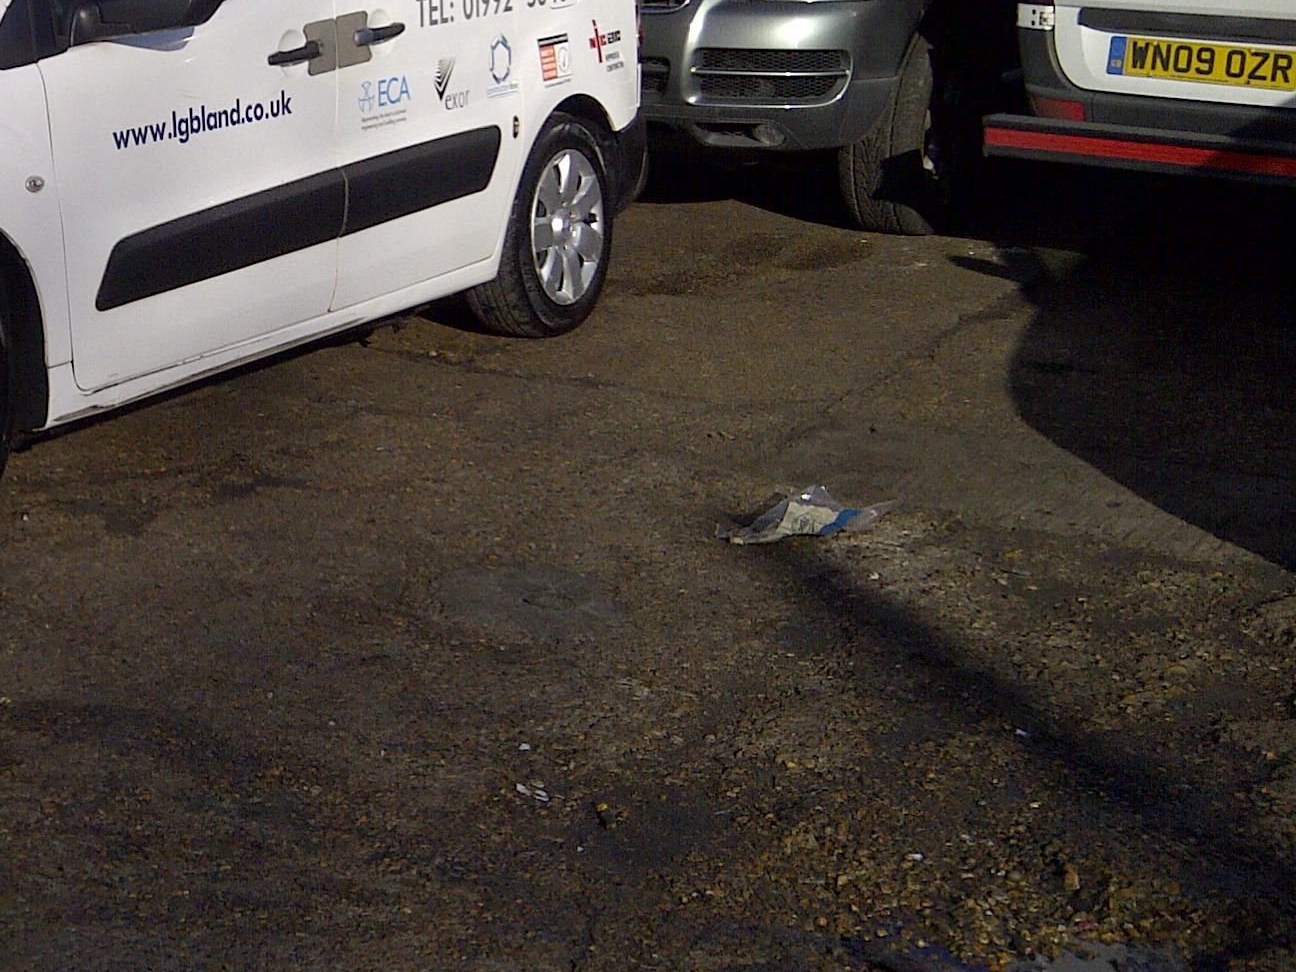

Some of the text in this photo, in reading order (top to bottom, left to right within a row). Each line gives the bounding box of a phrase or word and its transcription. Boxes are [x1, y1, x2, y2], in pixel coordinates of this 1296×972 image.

[1131, 41, 1216, 76] WN09
[377, 76, 411, 107] ECA
[112, 90, 292, 150] www.lgbland.co.uk
